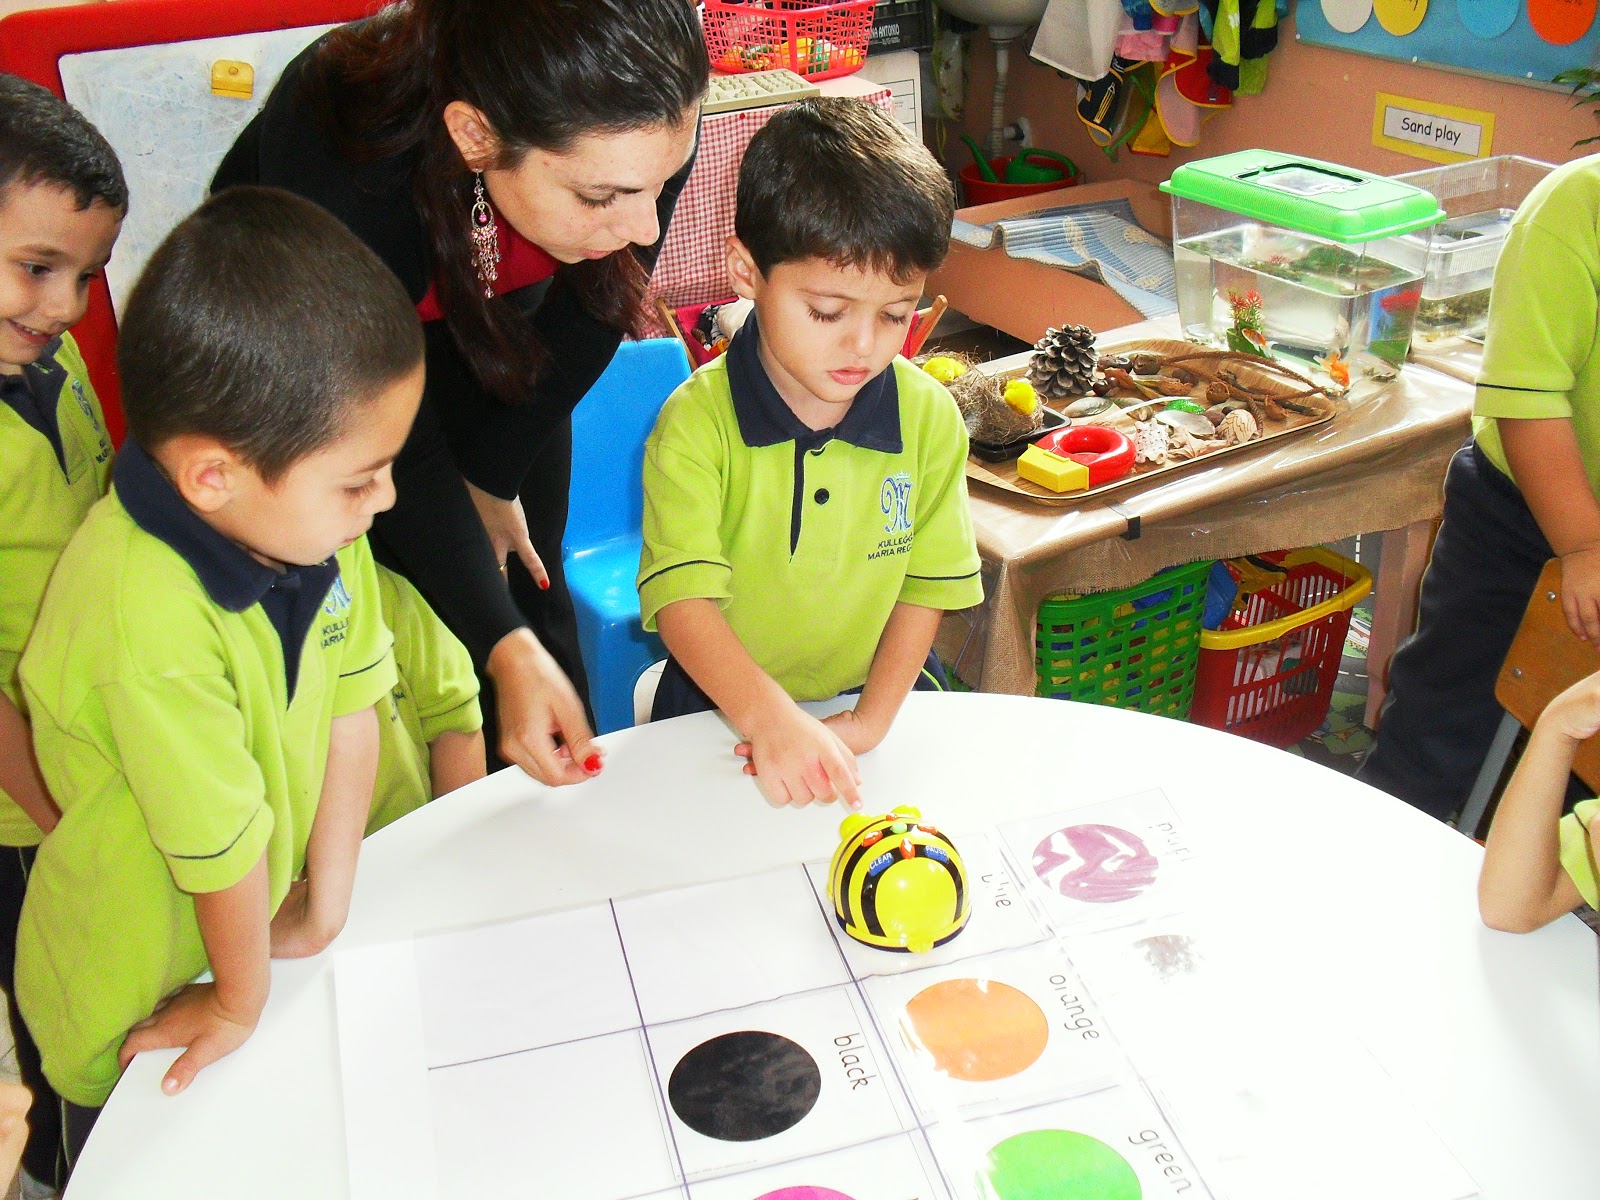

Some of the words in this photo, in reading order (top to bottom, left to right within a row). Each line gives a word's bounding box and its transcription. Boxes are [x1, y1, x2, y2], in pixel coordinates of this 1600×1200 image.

[878, 23, 900, 38] ANTONIO
[1401, 117, 1432, 136] Sand
[1435, 124, 1461, 146] play
[867, 548, 895, 561] MARIA
[869, 852, 892, 870] CLEAR
[1049, 974, 1100, 1040] orange
[833, 1032, 877, 1090] black
[1128, 1129, 1192, 1194] green
